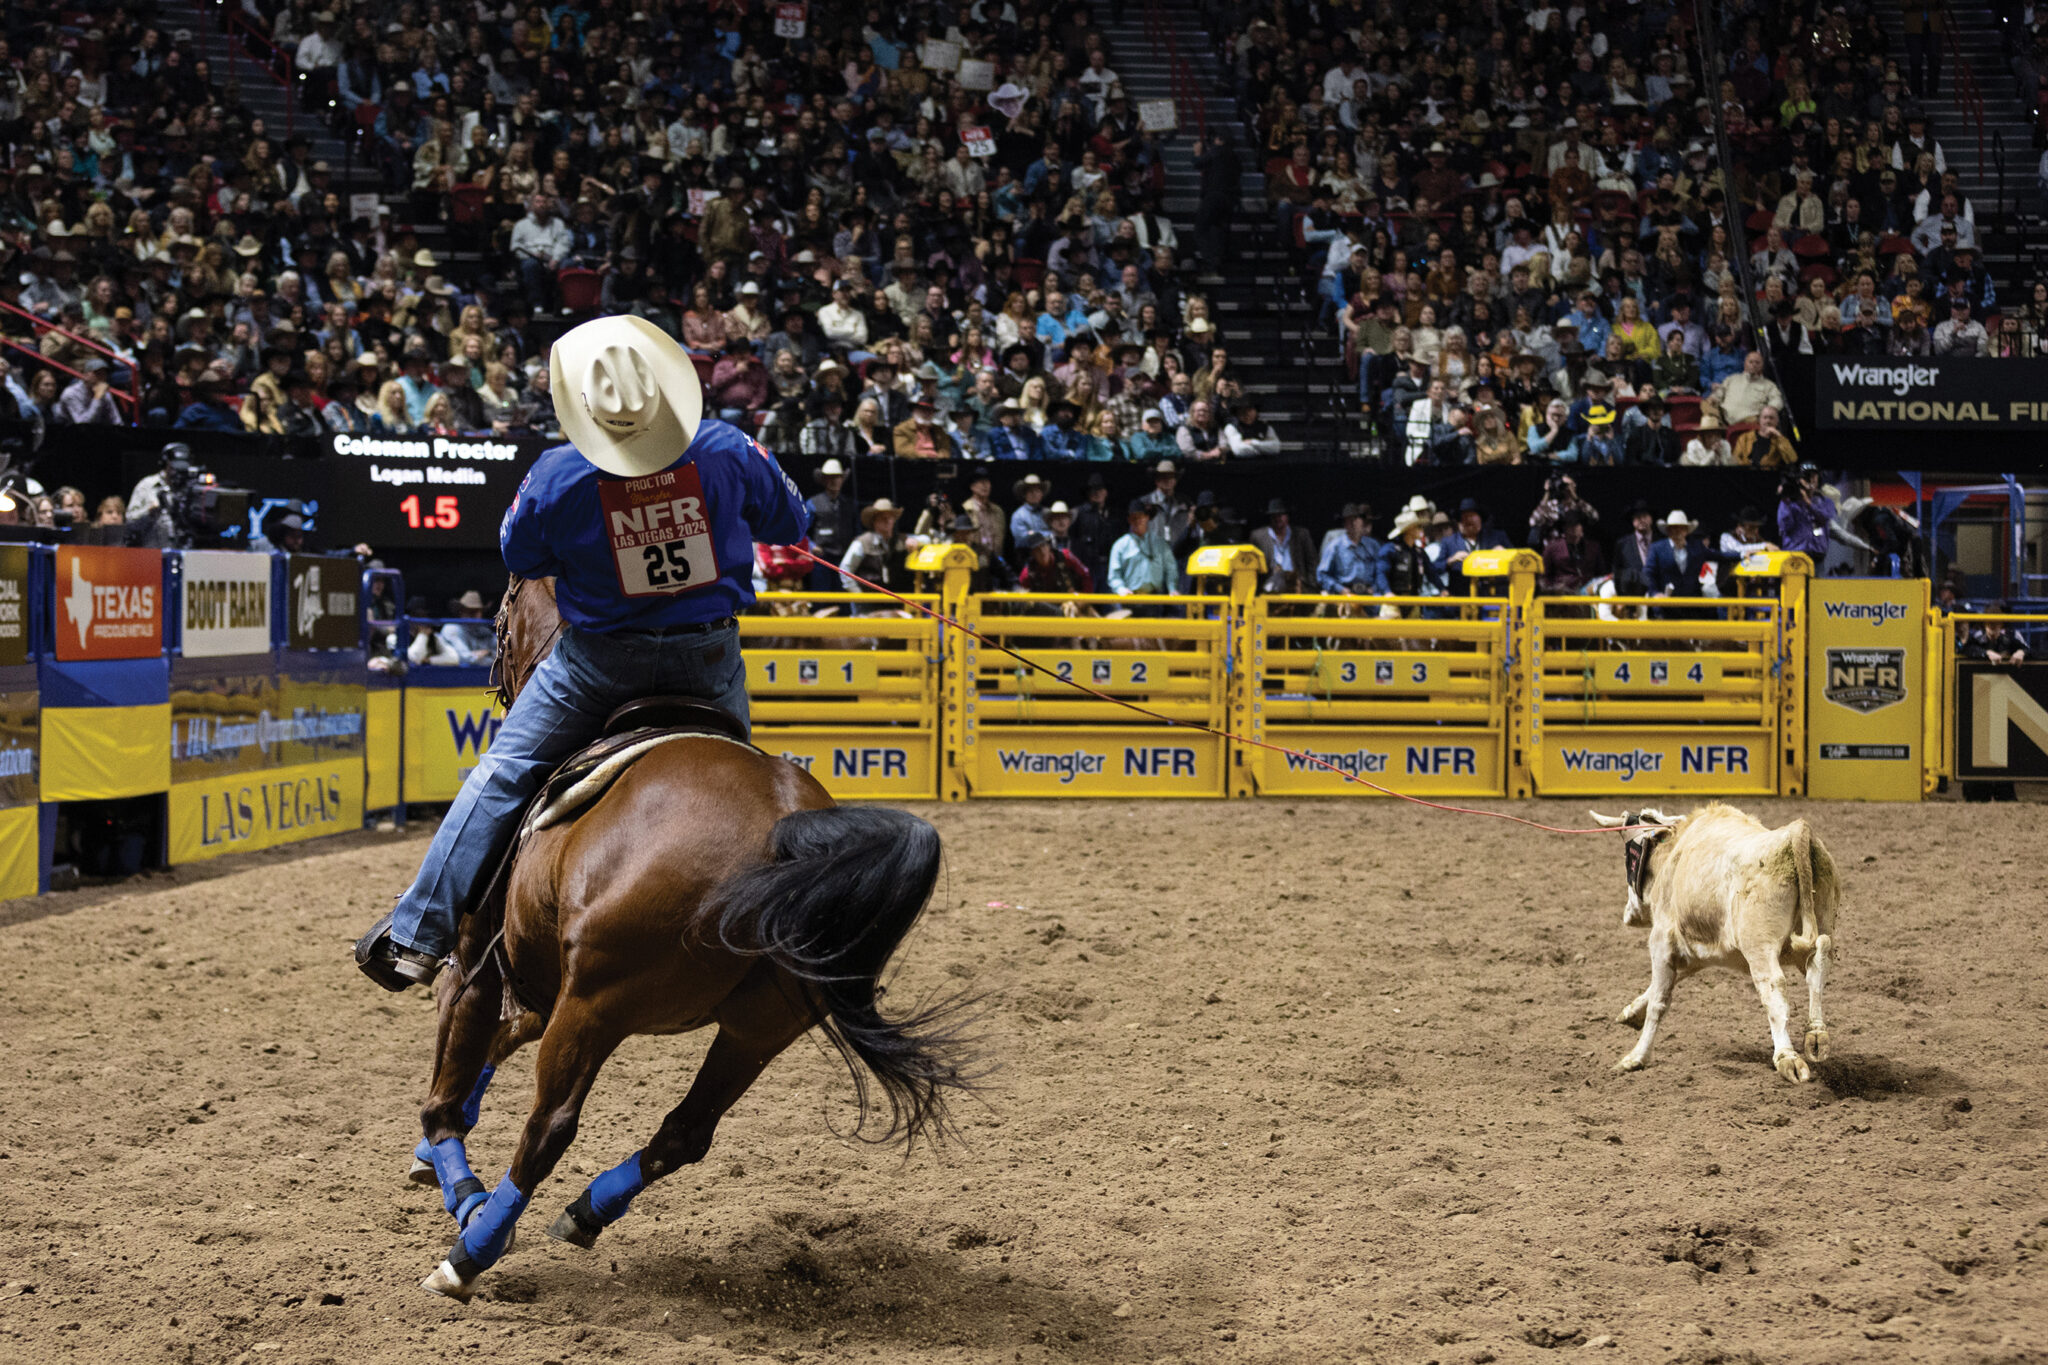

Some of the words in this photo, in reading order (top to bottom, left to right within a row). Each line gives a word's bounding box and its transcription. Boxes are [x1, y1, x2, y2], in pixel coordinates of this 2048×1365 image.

[1832, 363, 1939, 396] Wrangler
[1833, 401, 1999, 421] NATIONAL
[333, 434, 430, 458] Coleman
[433, 438, 518, 460] Proctor
[370, 464, 424, 486] Logan
[426, 466, 486, 485] Medlin
[625, 472, 676, 493] PROCTOR
[400, 494, 460, 529] 1.5
[610, 496, 703, 536] NFR
[613, 534, 636, 549] LAS
[638, 527, 674, 545] VEGAS
[677, 520, 707, 537] 2024
[643, 540, 691, 586] 25
[93, 586, 154, 619] TEXAS
[186, 580, 227, 630] BOOT
[229, 580, 267, 629] BARN
[1824, 602, 1908, 626] Wrangler
[764, 660, 777, 683] 1
[841, 660, 854, 683] 1
[1056, 661, 1073, 683] 2
[1130, 661, 1147, 684] 2
[1340, 661, 1357, 684] 3
[1411, 662, 1428, 684] 3
[1614, 661, 1631, 684] 4
[1687, 662, 1704, 684] 4
[1842, 652, 1890, 668] Wrangler
[1833, 667, 1898, 687] NFR
[833, 747, 909, 778] NFR
[997, 750, 1106, 784] Wrangler
[1123, 747, 1196, 777] NFR
[1284, 749, 1389, 782] Wrangler
[1406, 746, 1476, 775] NFR
[1562, 748, 1664, 782] Wrangler
[1680, 745, 1749, 774] NFR
[200, 787, 254, 846] LAS
[261, 773, 341, 831] VEGAS
